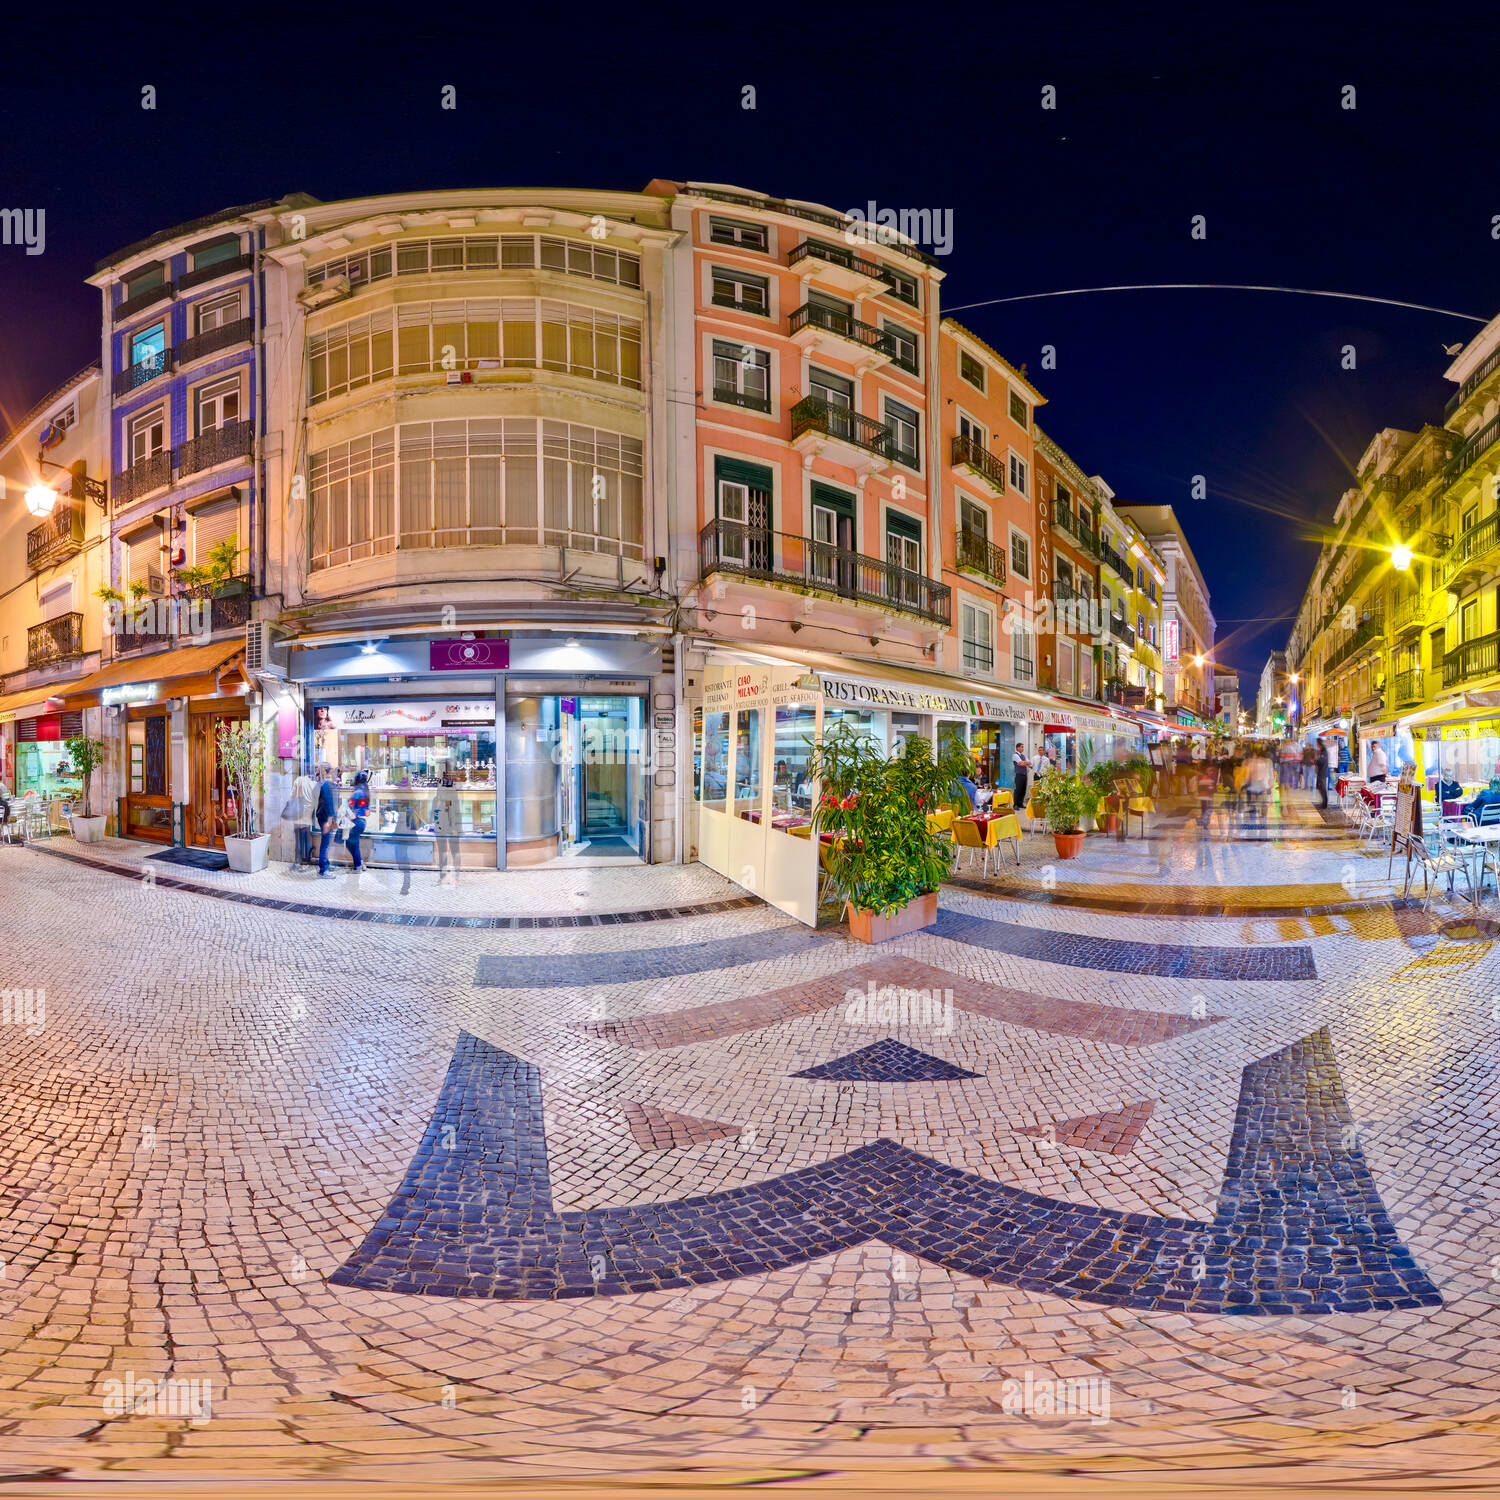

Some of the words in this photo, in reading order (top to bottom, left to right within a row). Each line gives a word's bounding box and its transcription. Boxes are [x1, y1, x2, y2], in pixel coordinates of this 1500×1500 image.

[1038, 486, 1049, 607] LOCANDA
[737, 674, 751, 686] CIAO
[737, 685, 759, 698] MILANO
[823, 680, 917, 708] RISTORANTE
[919, 694, 969, 713] ITALIANO
[1028, 708, 1044, 722] CIAO
[1051, 712, 1073, 725] MILANO
